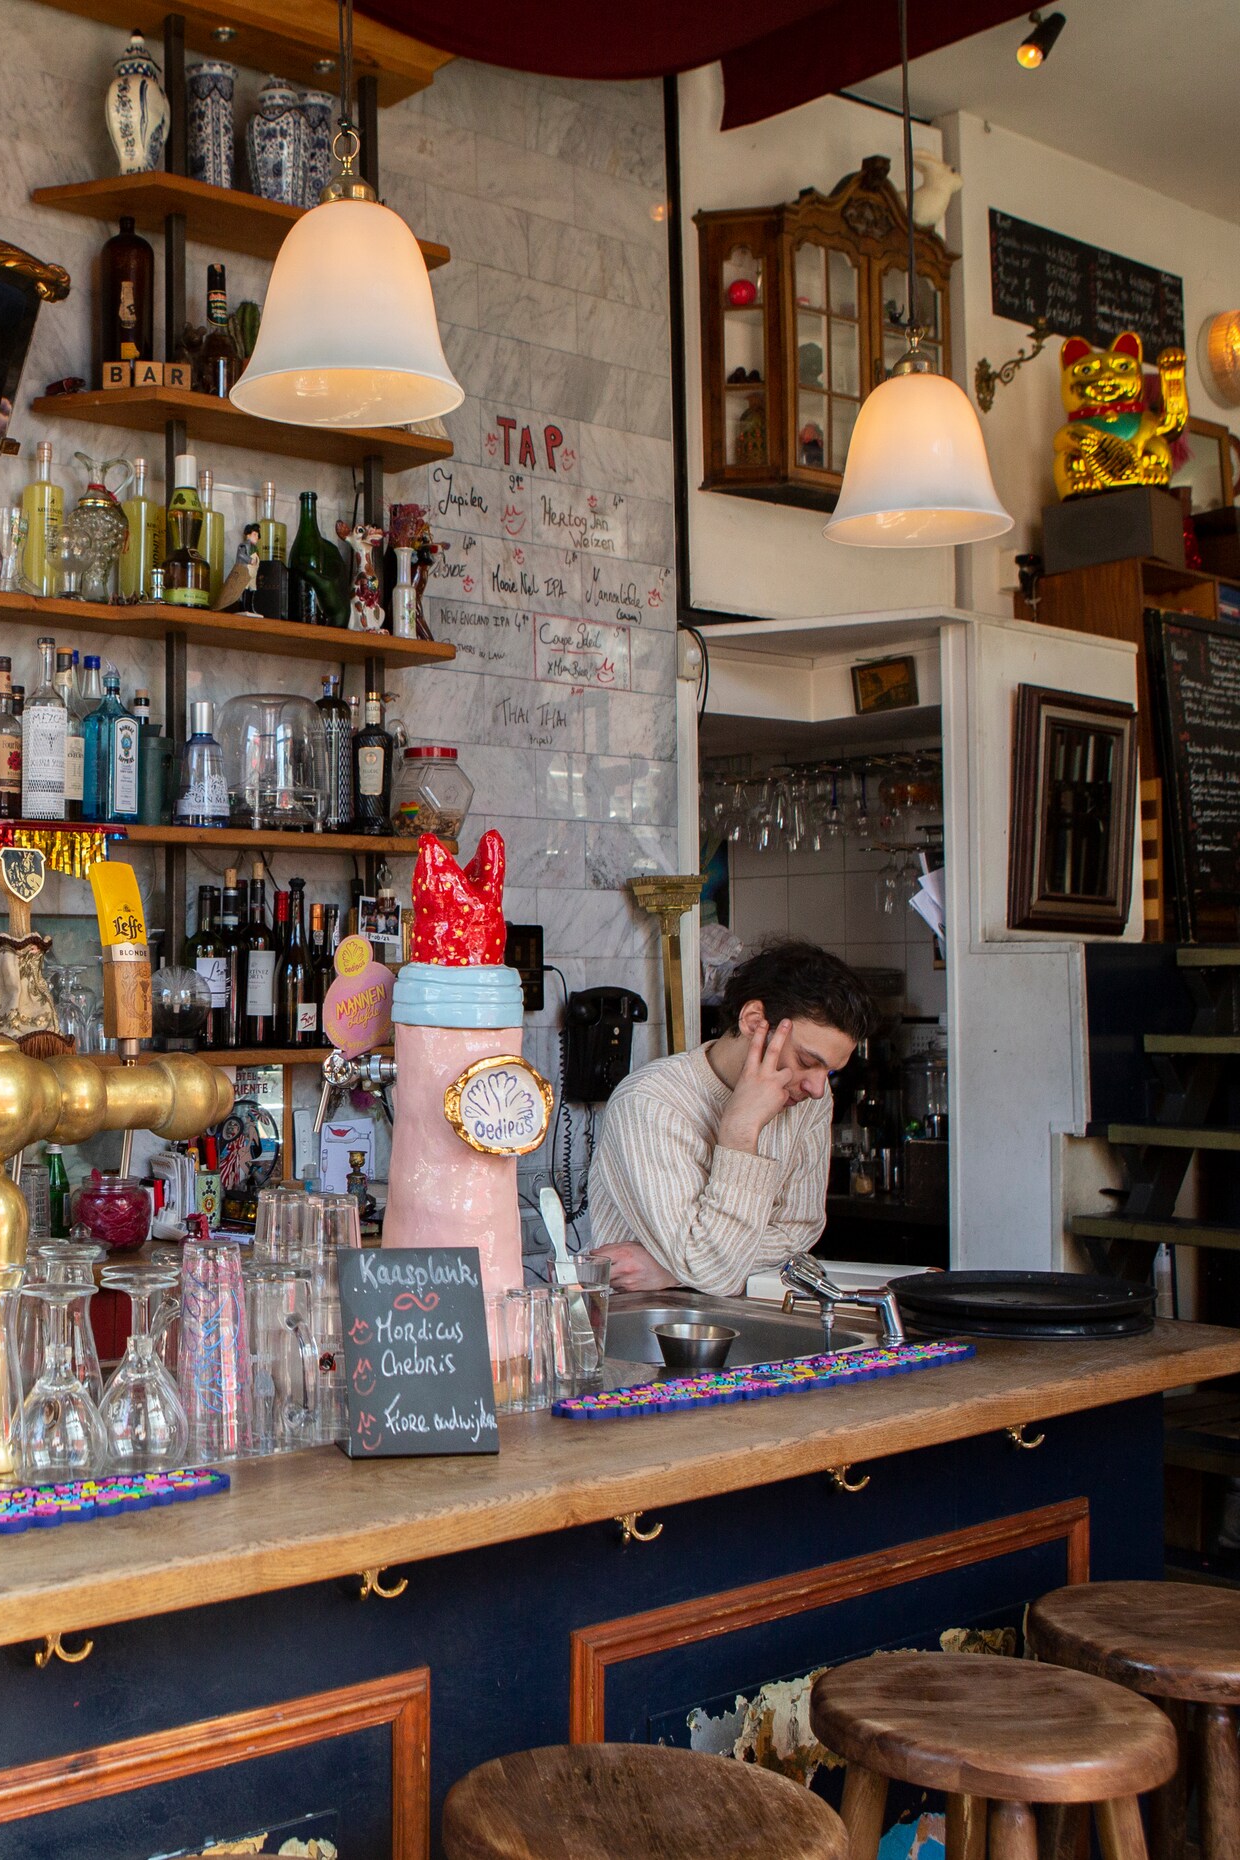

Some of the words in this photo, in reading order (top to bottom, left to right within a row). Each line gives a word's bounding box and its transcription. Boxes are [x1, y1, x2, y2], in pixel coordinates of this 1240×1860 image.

[110, 366, 184, 386] BAR
[497, 415, 564, 473] TAP
[544, 577, 567, 598] IPA
[112, 914, 143, 940] Leffe
[119, 949, 147, 957] BLONDE
[344, 960, 366, 973] oedipus
[335, 983, 387, 1021] MANNEN
[236, 1071, 257, 1082] OTEL
[233, 1082, 269, 1096] RIENTE
